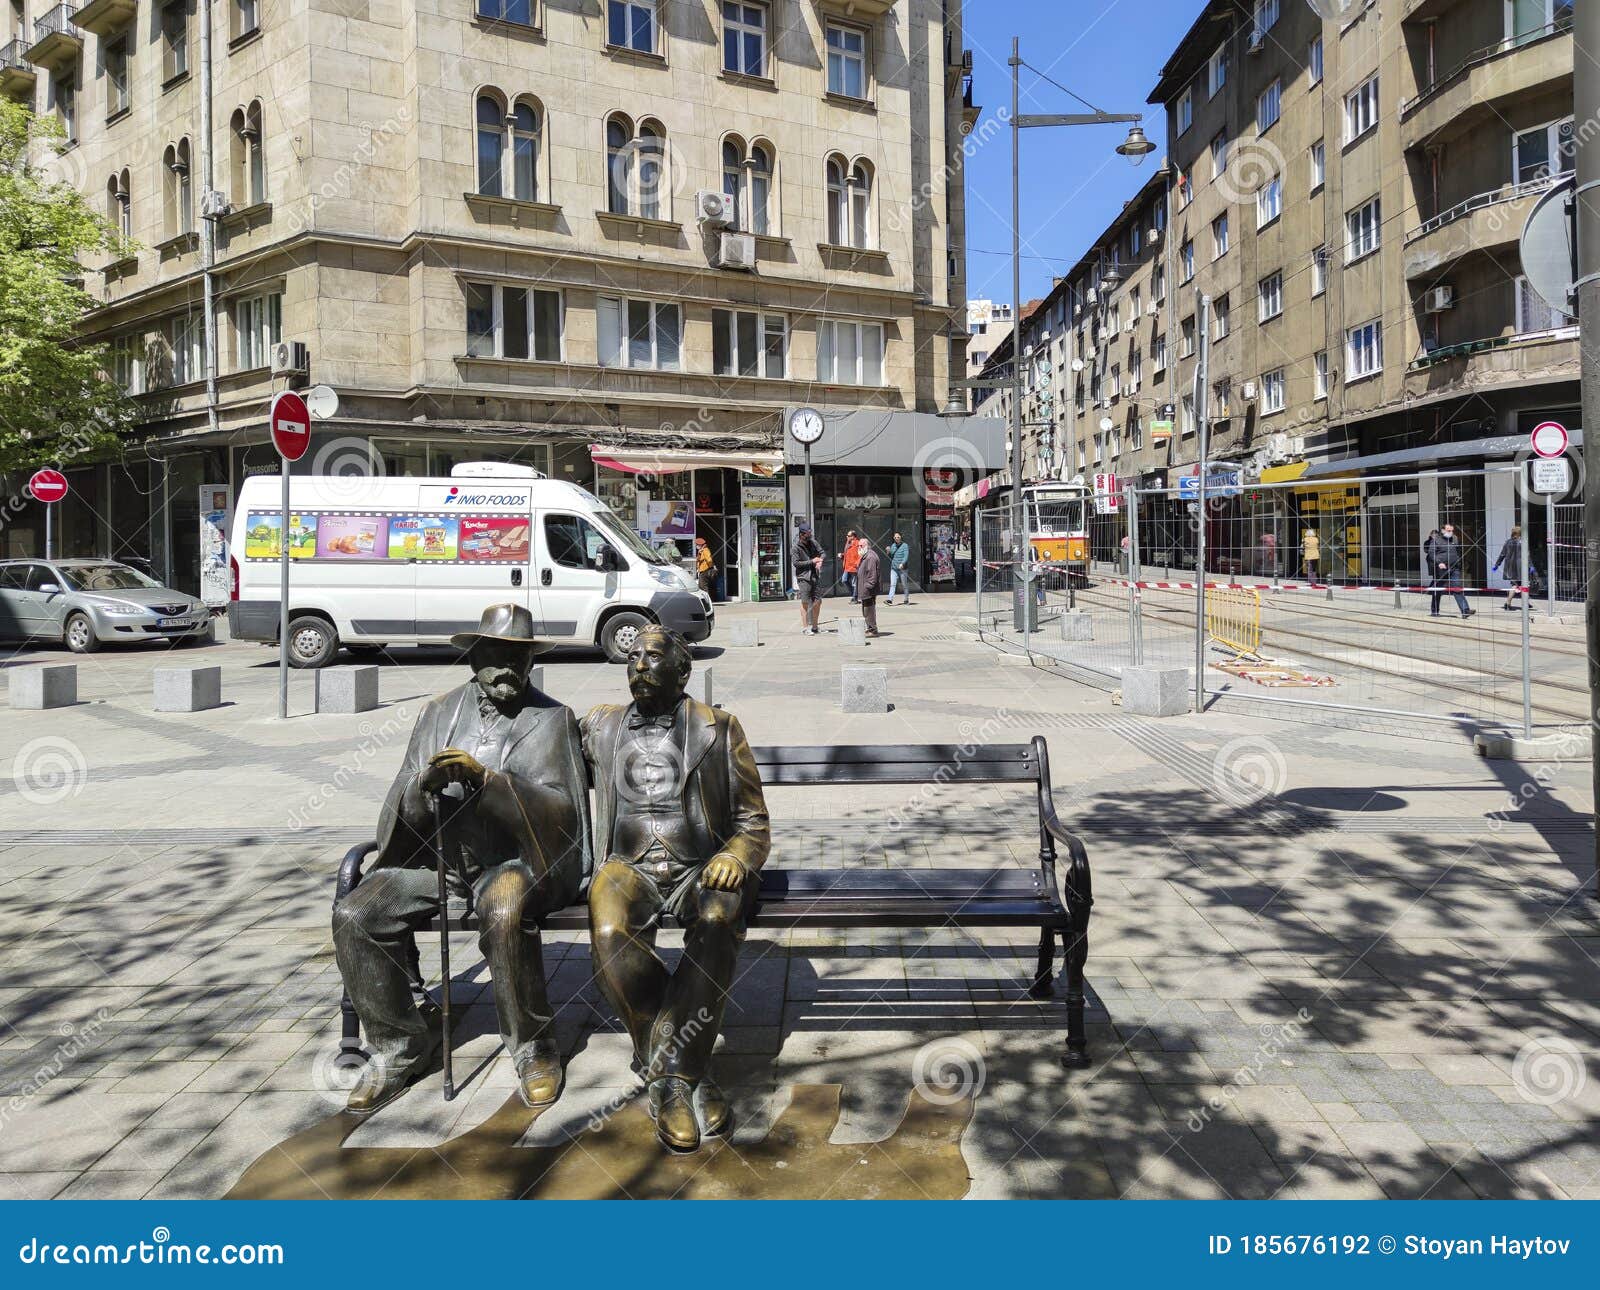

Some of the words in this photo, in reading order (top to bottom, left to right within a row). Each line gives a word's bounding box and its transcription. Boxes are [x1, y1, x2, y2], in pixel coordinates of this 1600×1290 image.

[244, 461, 279, 475] Panasonic
[457, 495, 486, 505] INKO
[486, 495, 527, 506] FOODS
[393, 521, 419, 529] HARIBO
